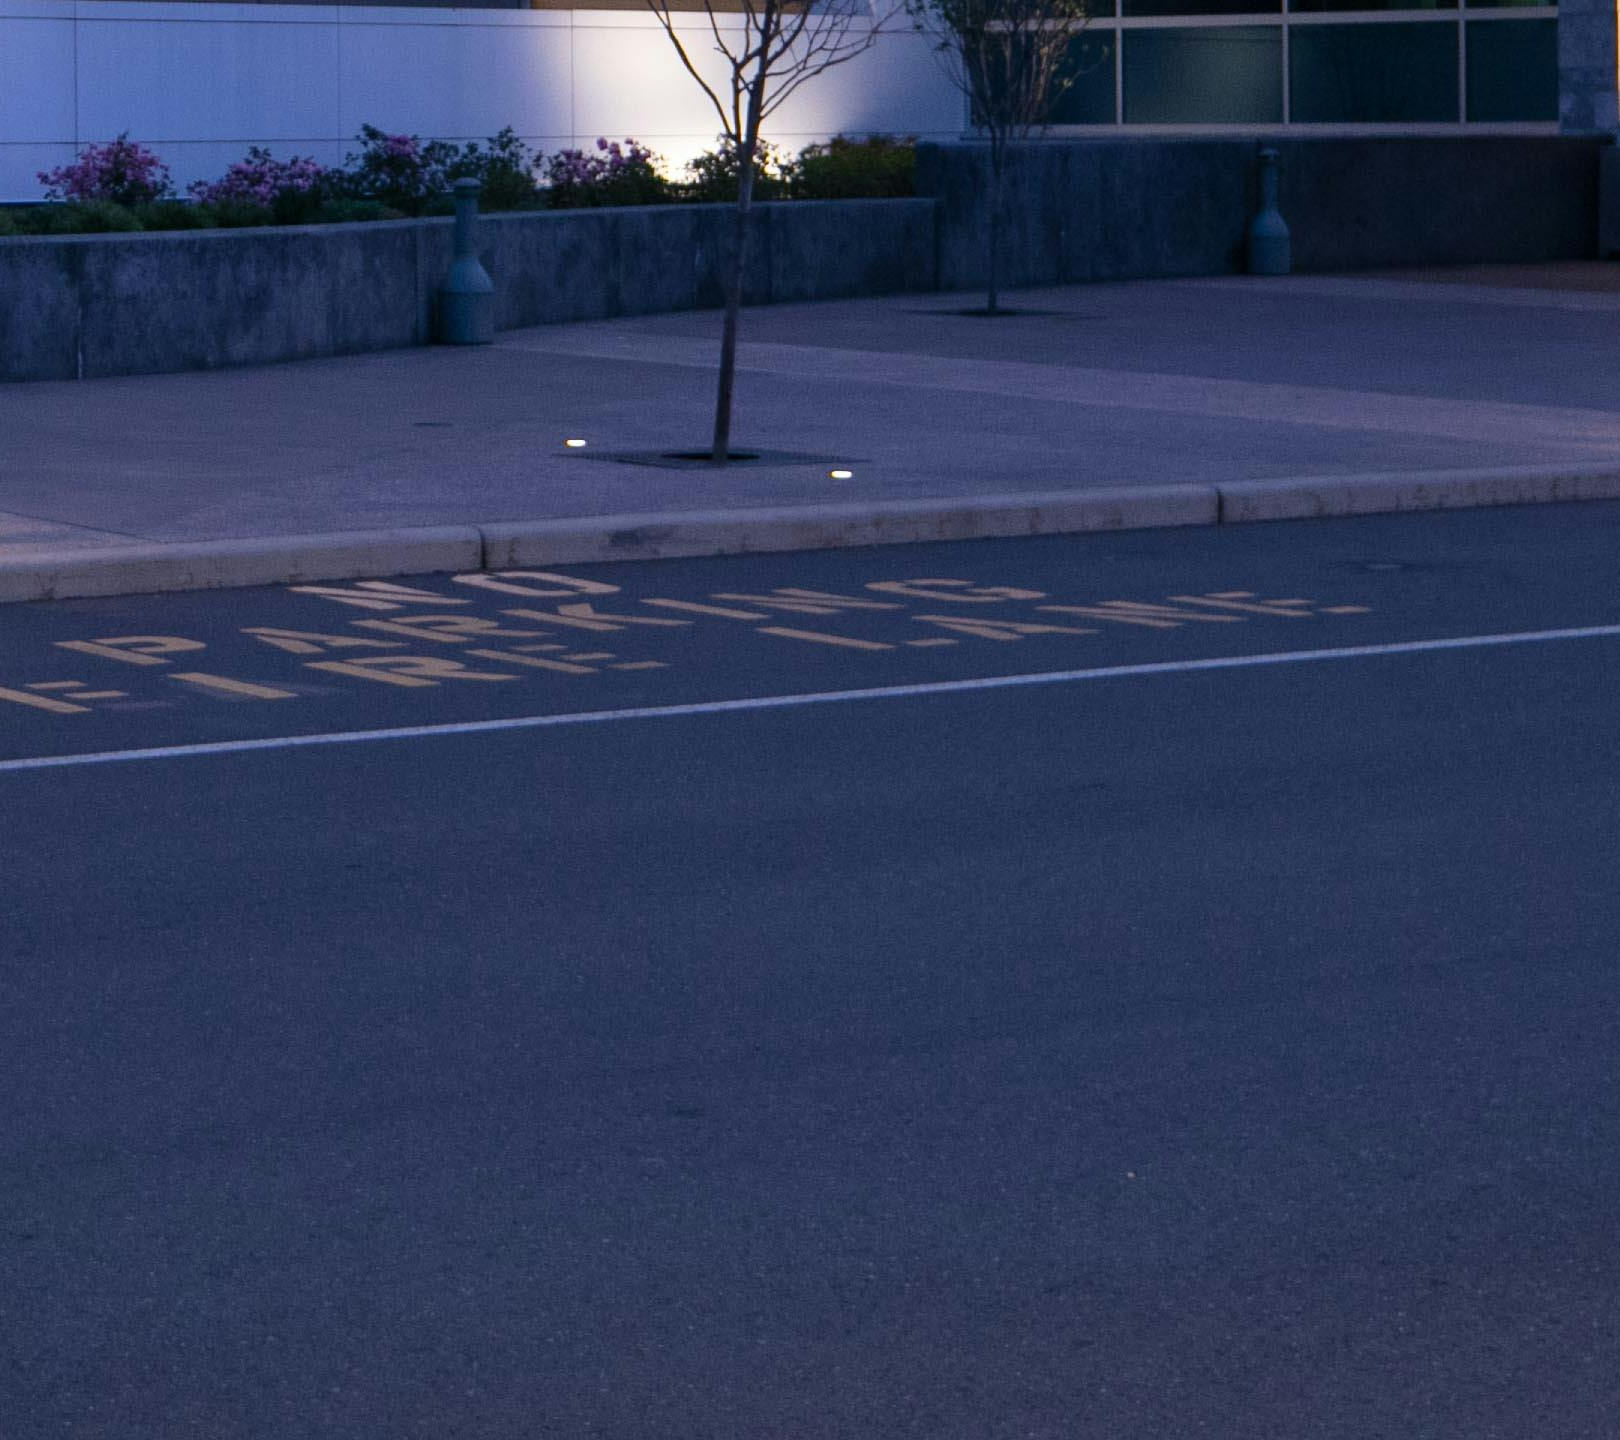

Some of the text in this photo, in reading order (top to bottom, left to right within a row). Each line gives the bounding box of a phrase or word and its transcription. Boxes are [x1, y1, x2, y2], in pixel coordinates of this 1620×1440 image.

[287, 570, 623, 611] NO
[757, 590, 1372, 650] LANE
[52, 578, 1048, 666] PARKING
